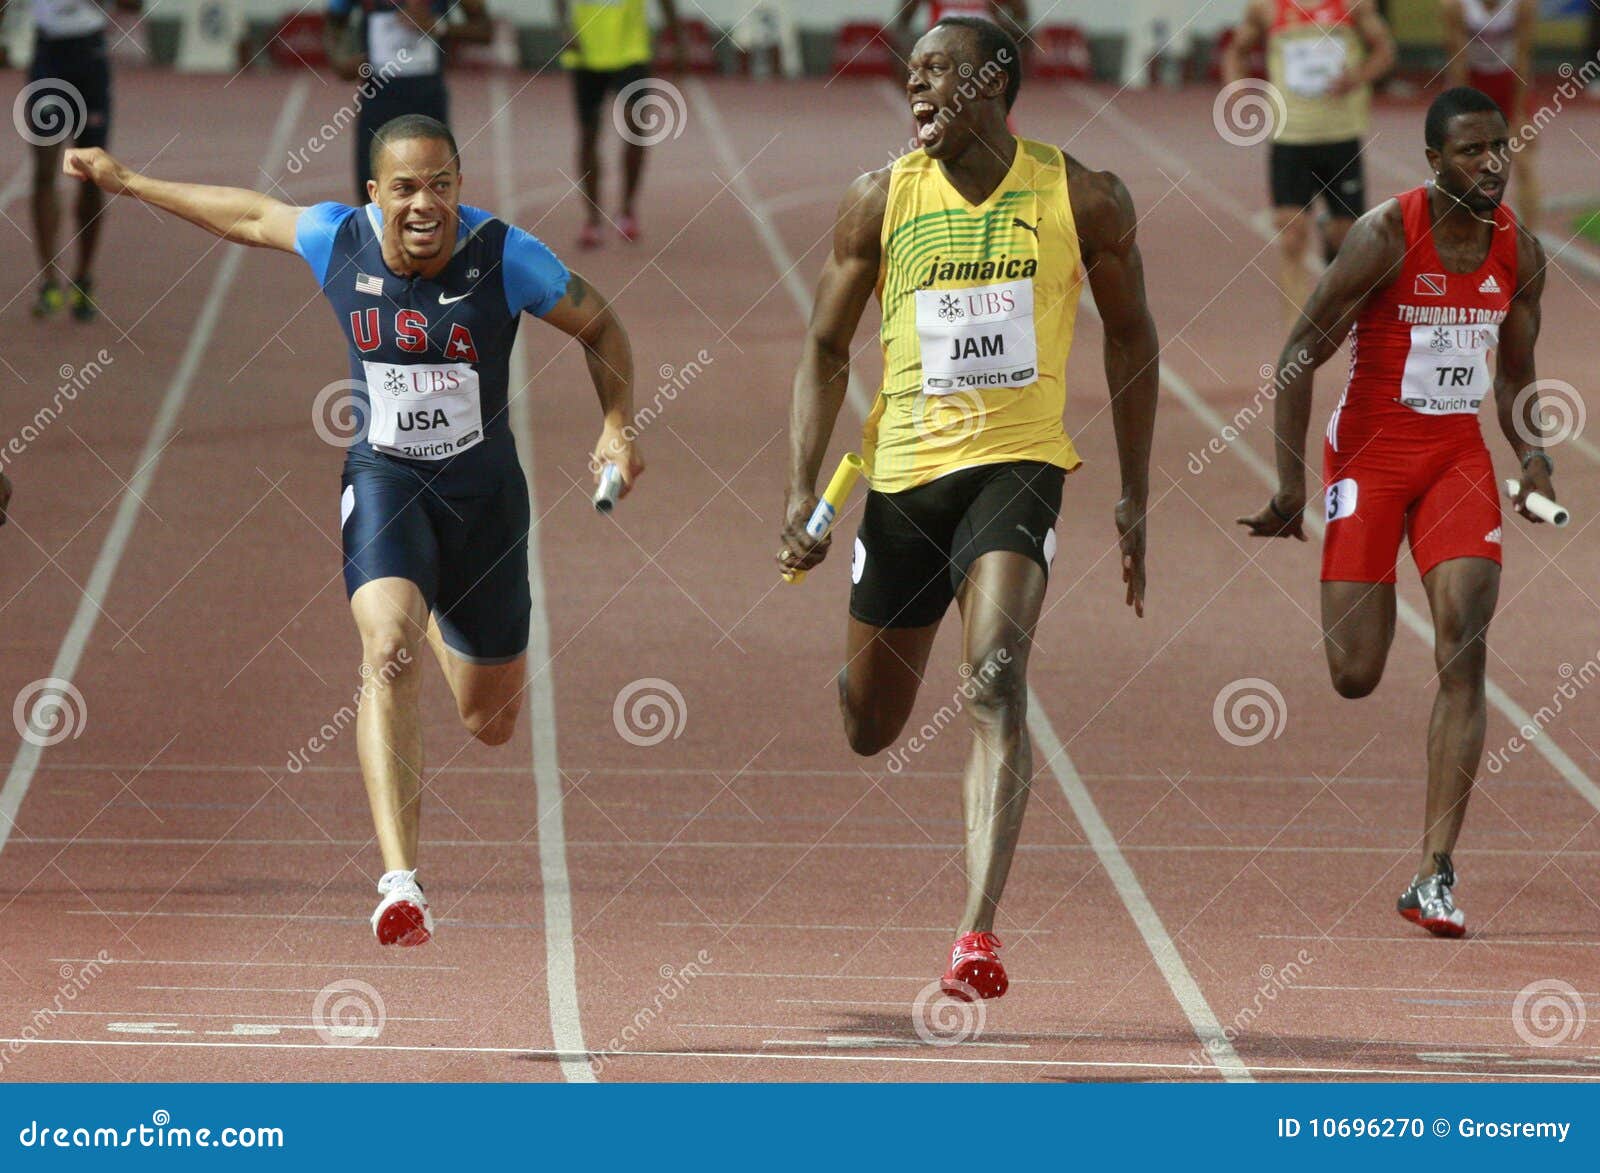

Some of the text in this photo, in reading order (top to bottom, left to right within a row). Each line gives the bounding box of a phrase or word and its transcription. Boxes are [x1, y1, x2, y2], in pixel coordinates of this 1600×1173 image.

[466, 268, 480, 278] JO
[922, 254, 1037, 286] jamaica
[968, 290, 1015, 316] UBS
[1398, 304, 1457, 324] TRINIDAD
[1459, 307, 1468, 323] &
[350, 307, 479, 362] USA
[950, 334, 1004, 360] JAM
[411, 369, 460, 394] UBS
[1436, 366, 1474, 386] TRI
[397, 408, 450, 431] USA
[1328, 485, 1338, 519] 3
